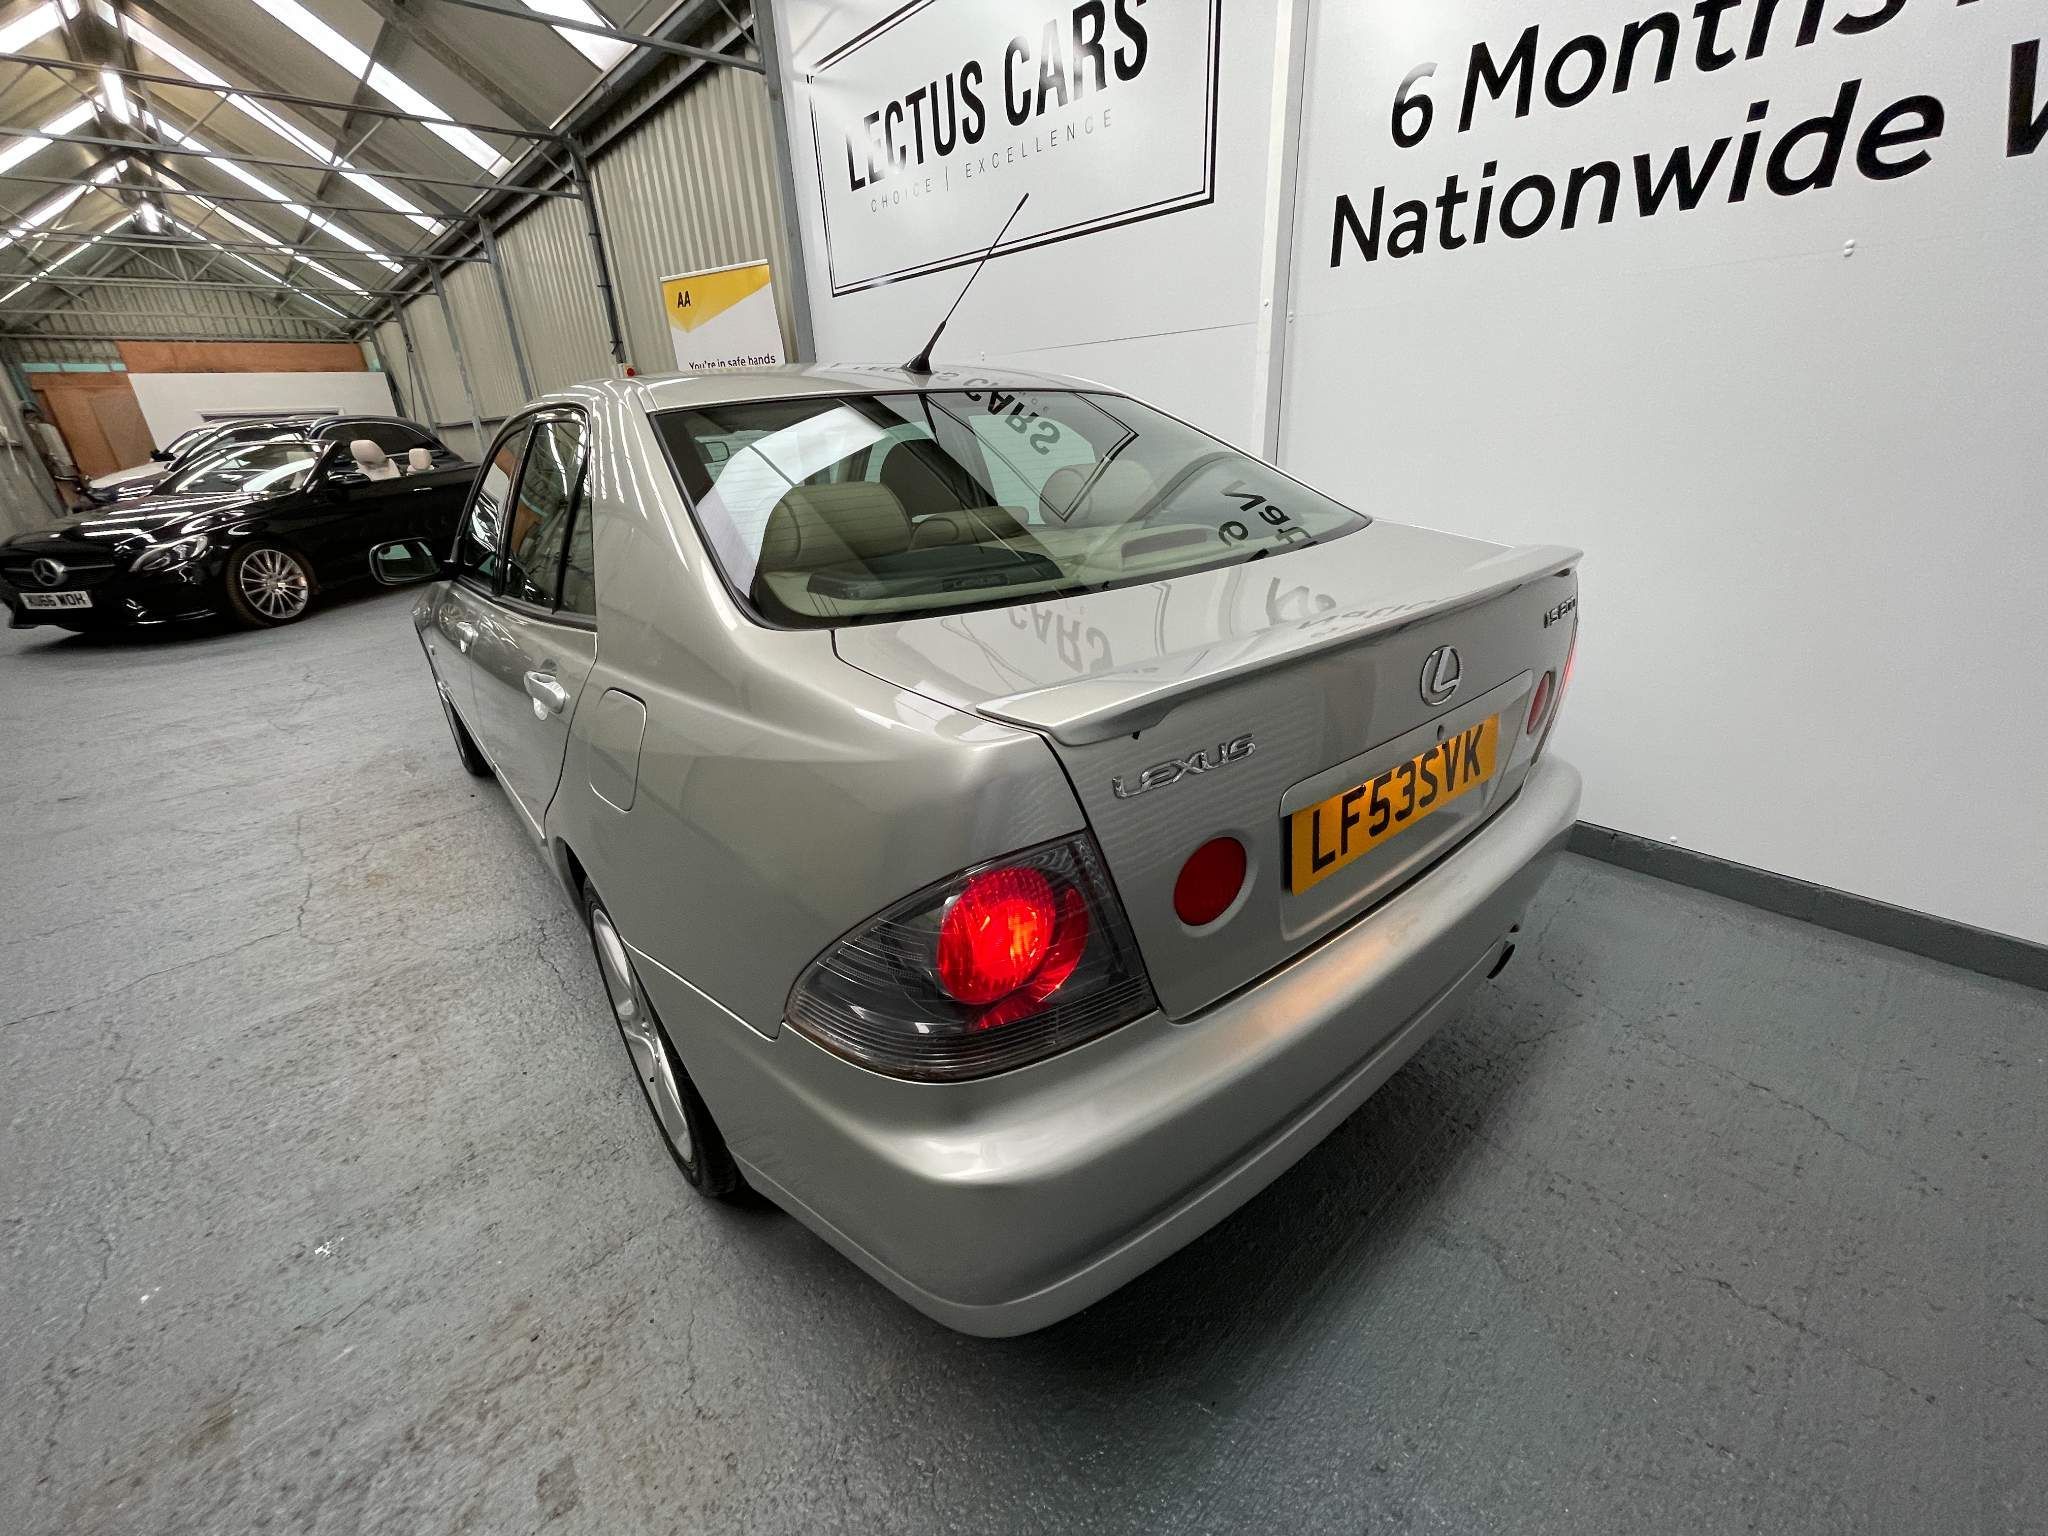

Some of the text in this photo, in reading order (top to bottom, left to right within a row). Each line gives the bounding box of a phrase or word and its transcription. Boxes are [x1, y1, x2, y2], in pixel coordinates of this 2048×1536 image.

[845, 0, 1148, 192] LECTUS CARS
[1391, 62, 1438, 148] 6
[870, 178, 932, 213] CHOICE
[965, 108, 1112, 179] EXCELLENCE
[1329, 78, 1945, 268] Nationwide
[677, 291, 692, 308] AA
[727, 356, 746, 367] safe
[747, 353, 776, 366] hands
[1112, 732, 1257, 800] LEXUS
[1311, 723, 1485, 875] LF53SVK
